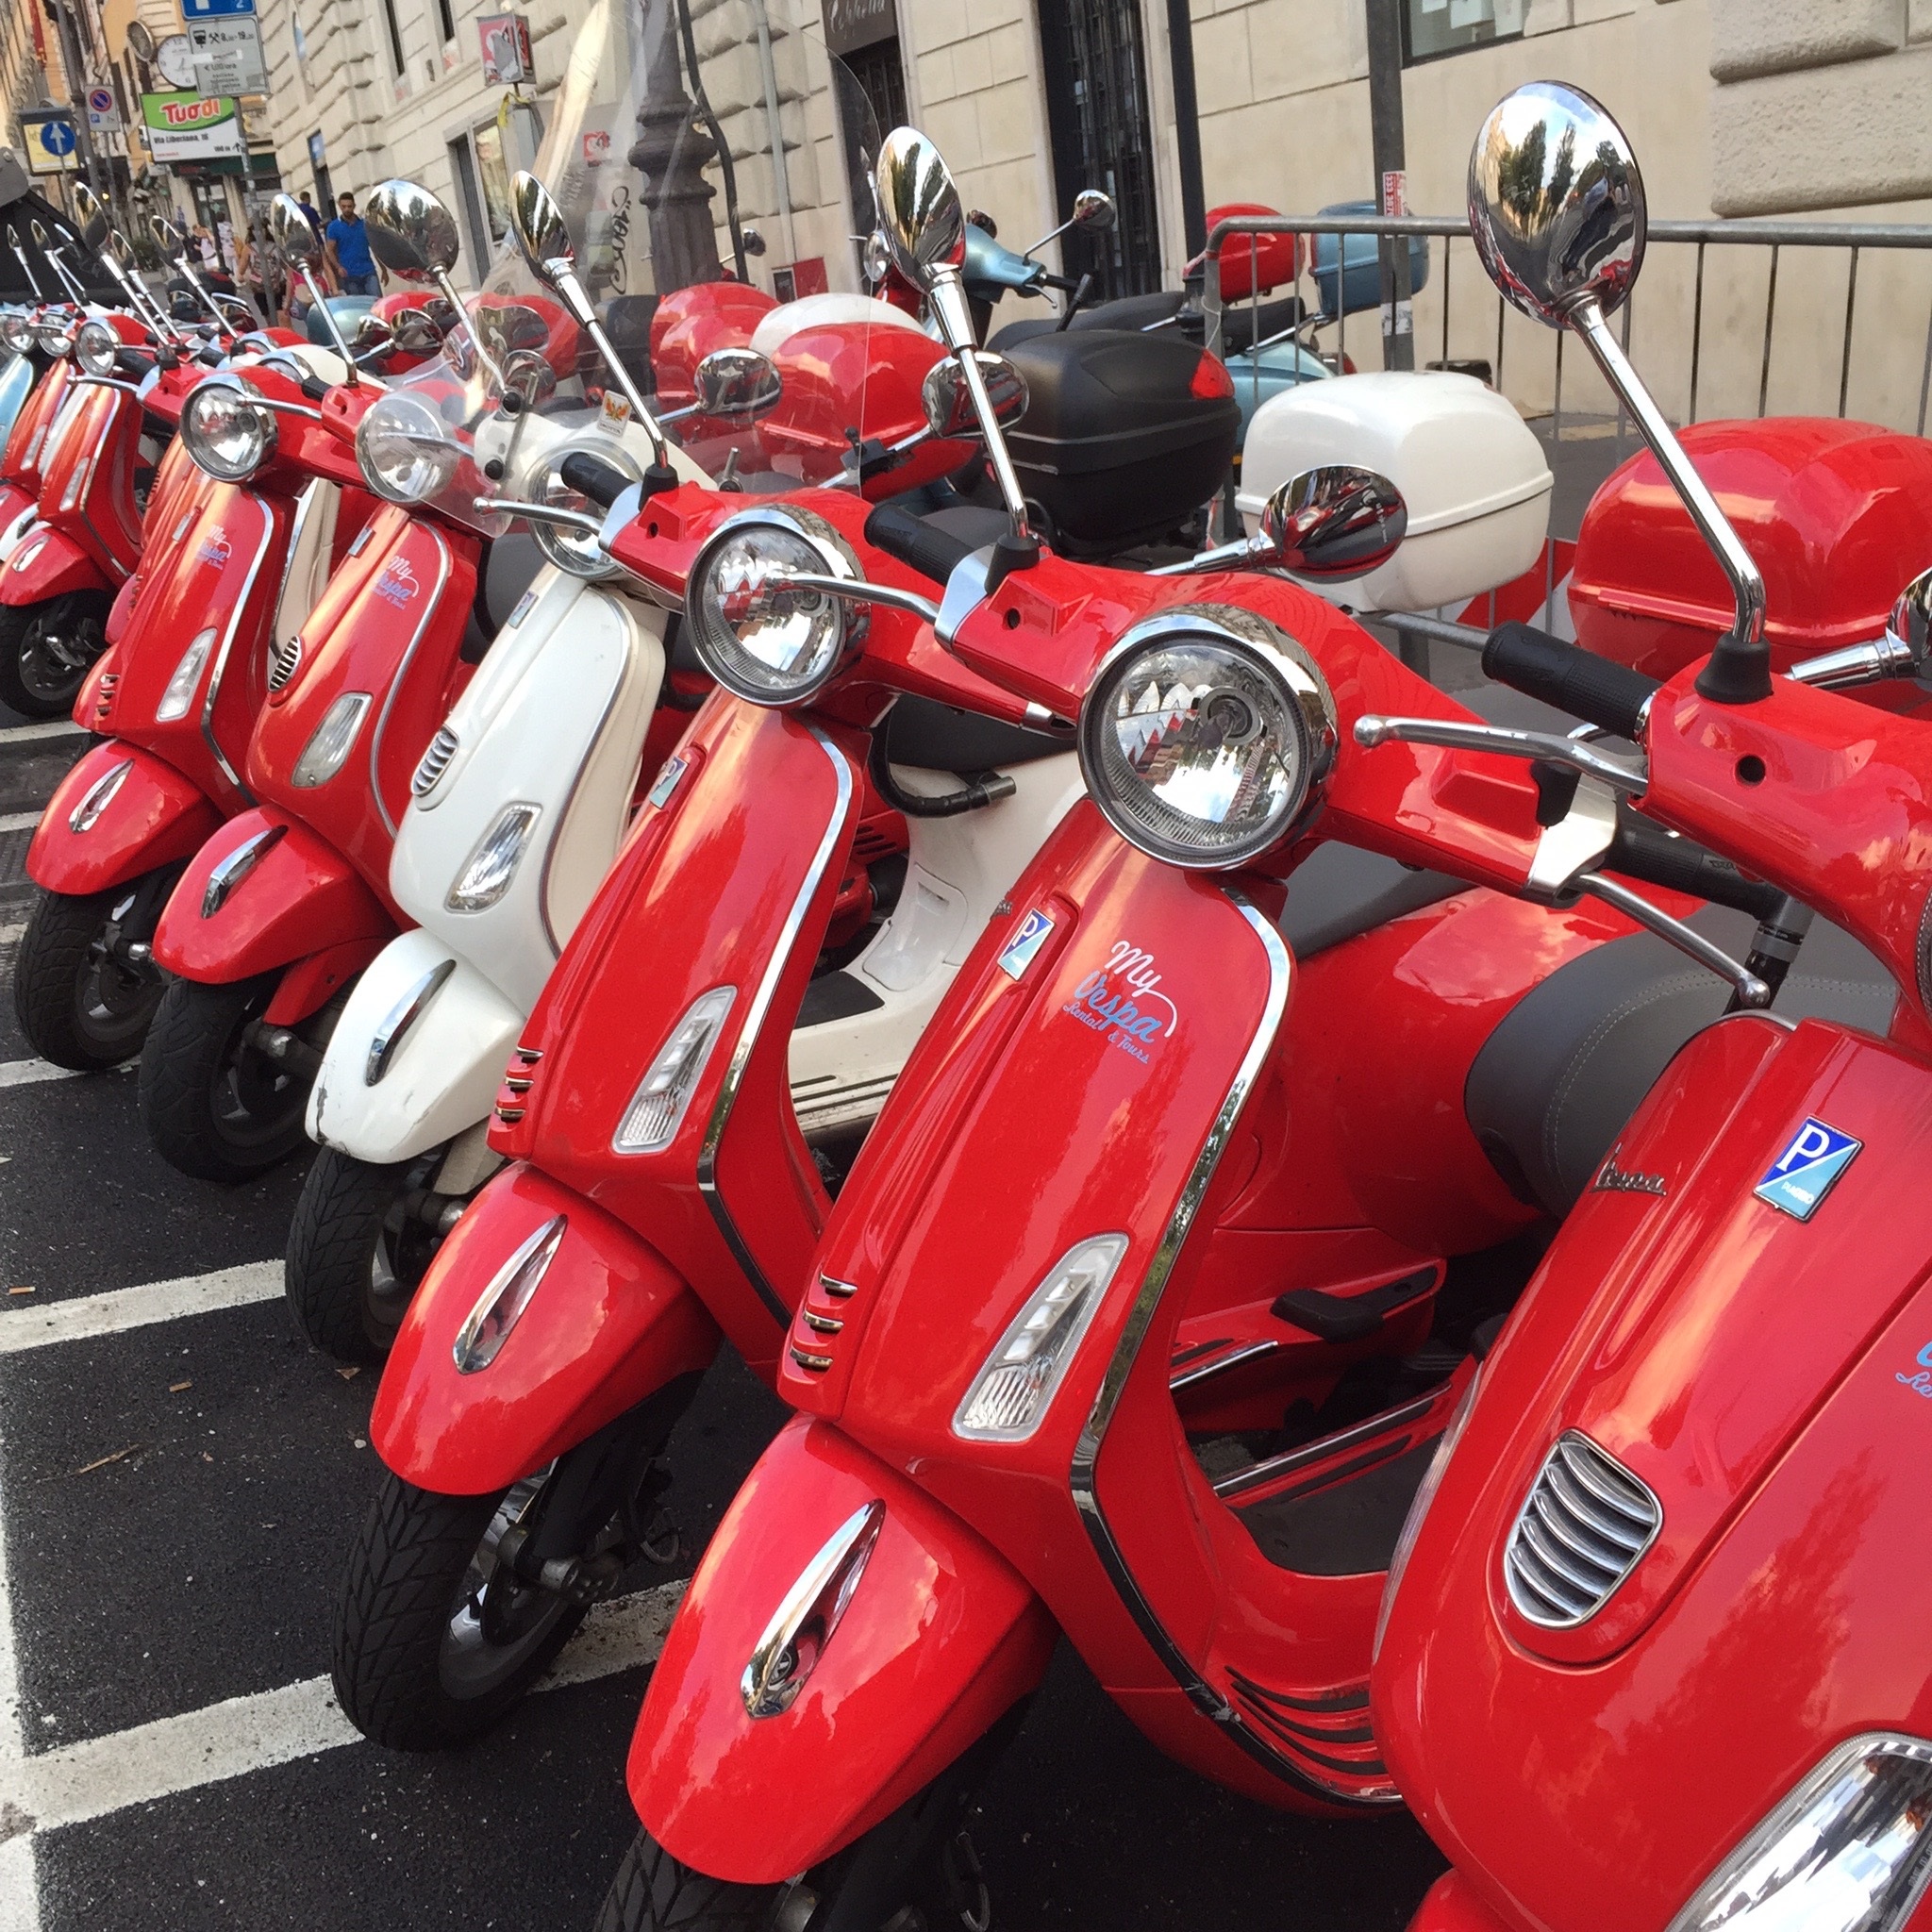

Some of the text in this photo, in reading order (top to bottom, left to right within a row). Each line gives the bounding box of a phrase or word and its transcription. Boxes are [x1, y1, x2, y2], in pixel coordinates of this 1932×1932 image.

[1011, 914, 1039, 947] P
[1074, 970, 1162, 1043] Vespa
[1104, 940, 1177, 1038] My
[1062, 1001, 1150, 1064] Rental & Tours
[1775, 1124, 1830, 1172] P
